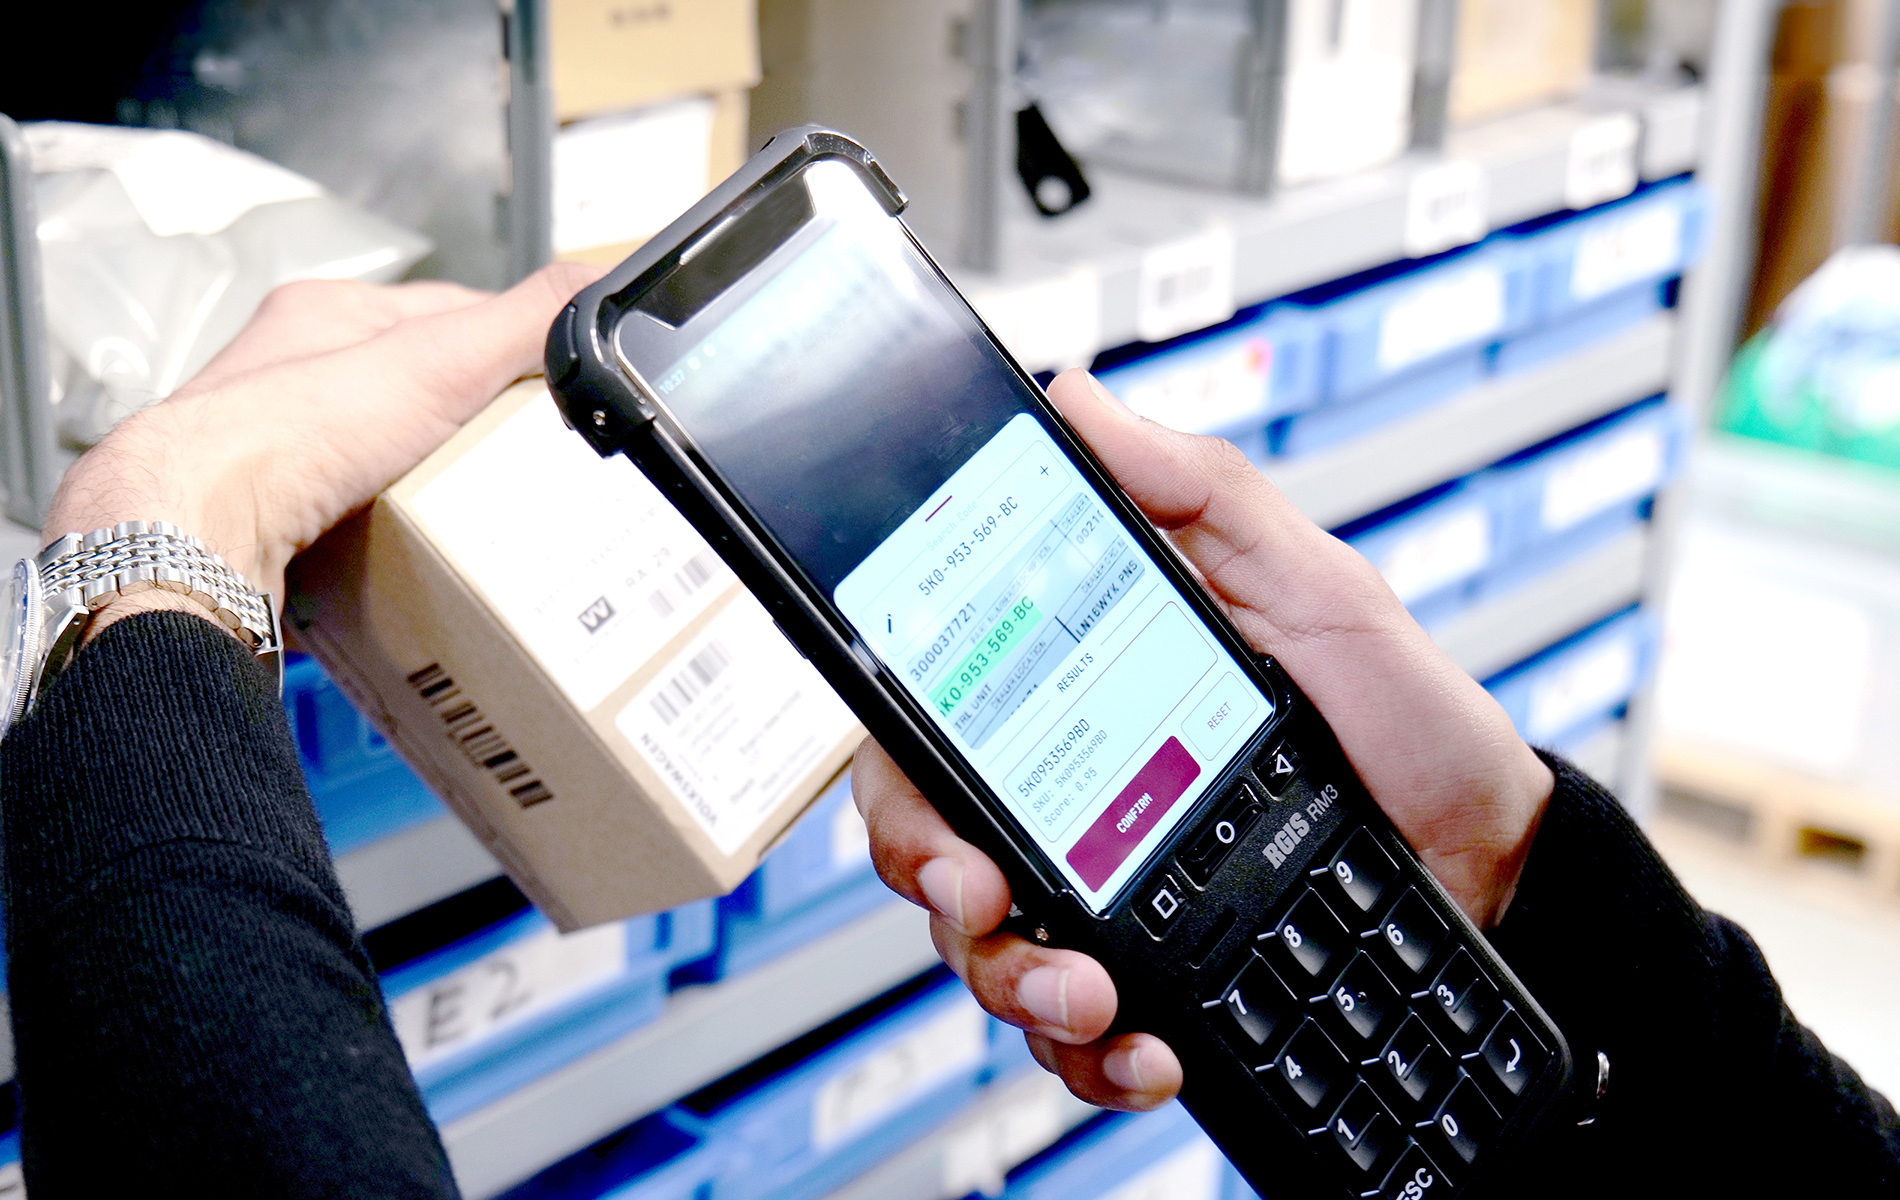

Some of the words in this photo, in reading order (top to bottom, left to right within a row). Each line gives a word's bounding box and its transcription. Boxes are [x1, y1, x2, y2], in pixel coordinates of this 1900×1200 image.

[927, 520, 956, 551] Search
[958, 501, 977, 522] Code
[919, 497, 1018, 596] 5K0-953-569-BC
[910, 603, 977, 682] 300037721
[1057, 652, 1094, 693] RESULTS
[954, 702, 973, 730] TRL
[970, 682, 993, 708] UNIT
[1207, 701, 1232, 731] RESET
[1018, 718, 1091, 798] 5K0953569BD
[1032, 791, 1056, 814] SKU:
[1043, 795, 1076, 827] Score:
[1075, 767, 1097, 792] 0.95
[1116, 792, 1154, 834] CONFIRM
[1261, 812, 1310, 869] RGIS
[1307, 784, 1339, 822] RM3
[1336, 860, 1353, 884] 9
[1283, 924, 1302, 948] 8
[1386, 923, 1404, 946] 6
[1228, 989, 1248, 1015] 7
[1336, 987, 1355, 1011] 5
[1437, 985, 1455, 1006] 3
[1284, 1055, 1302, 1080] 4
[1387, 1050, 1408, 1076] 2
[1337, 1118, 1354, 1140] 1
[1441, 1114, 1459, 1137] 0
[1396, 1168, 1433, 1200] SC
